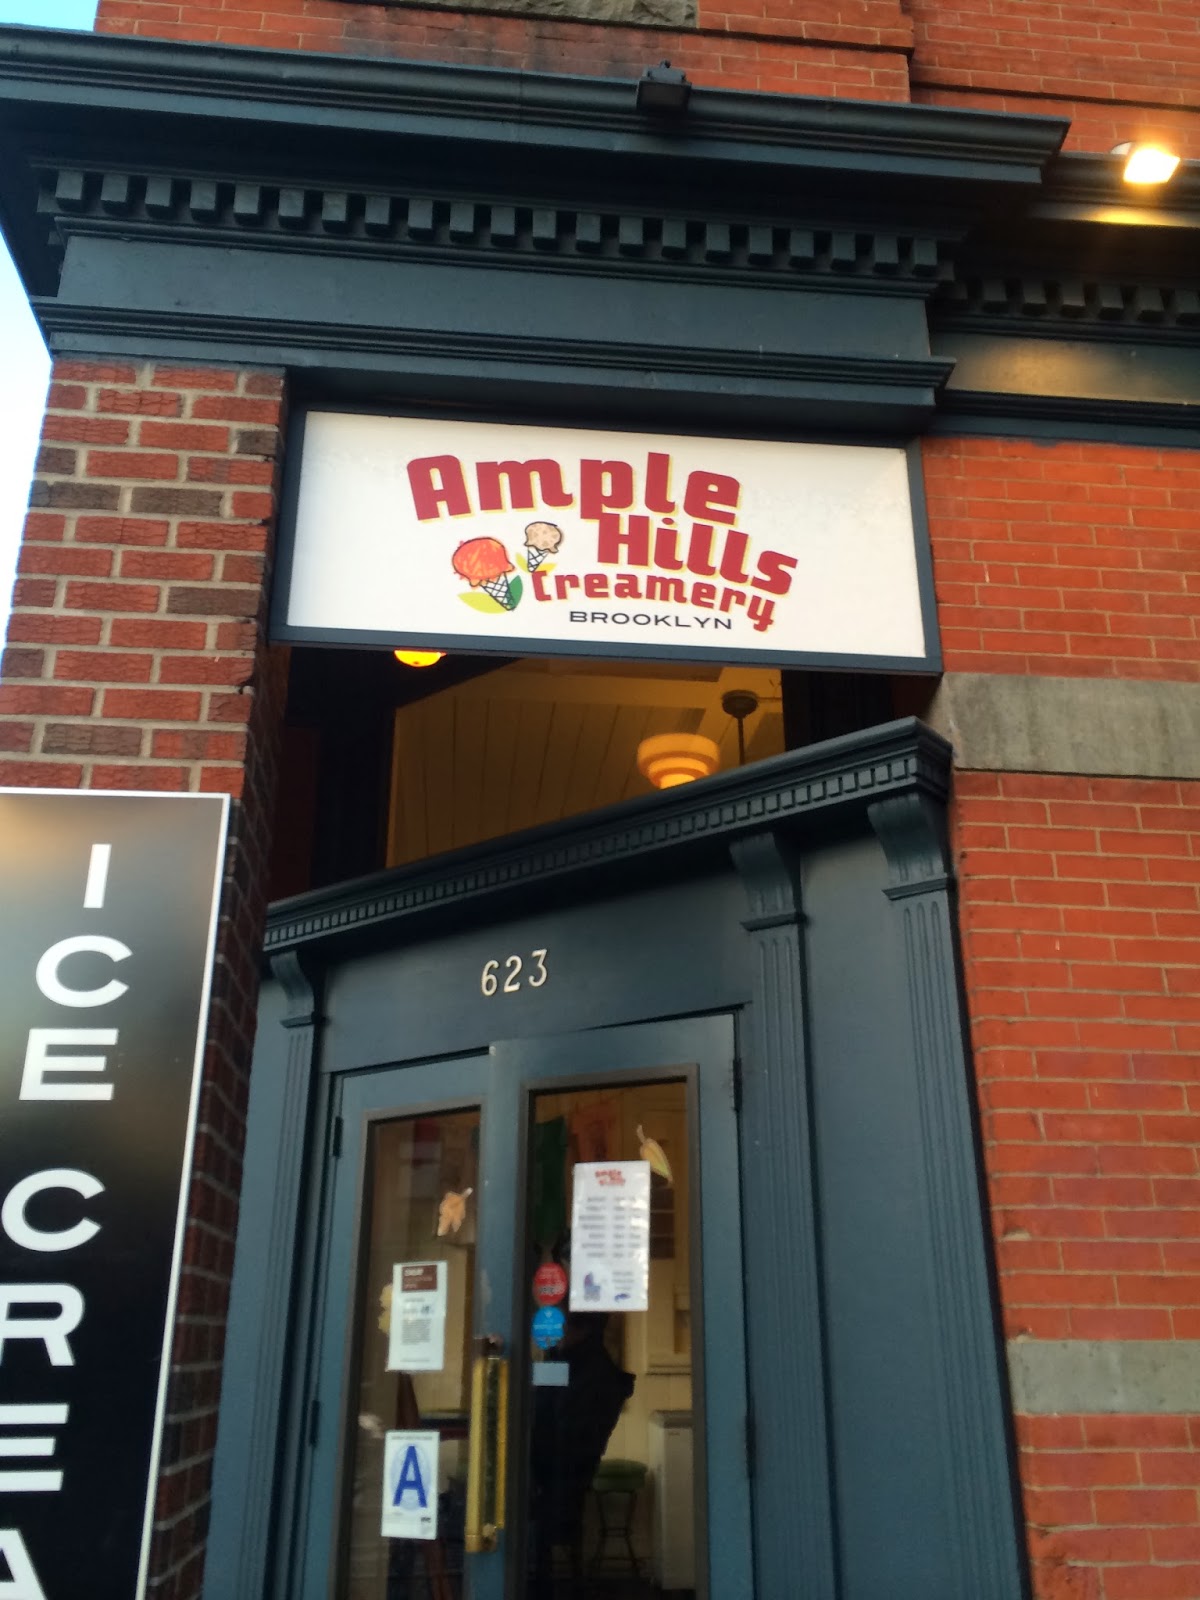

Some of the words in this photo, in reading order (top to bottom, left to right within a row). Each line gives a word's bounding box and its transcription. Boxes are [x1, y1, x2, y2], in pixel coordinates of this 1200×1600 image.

[406, 452, 740, 525] Ample
[597, 514, 798, 596] Hills
[531, 570, 776, 633] Creamery
[569, 611, 732, 630] BROOKLYN
[19, 843, 133, 1100] ICE
[481, 949, 547, 996] 623
[392, 1445, 427, 1508] A
